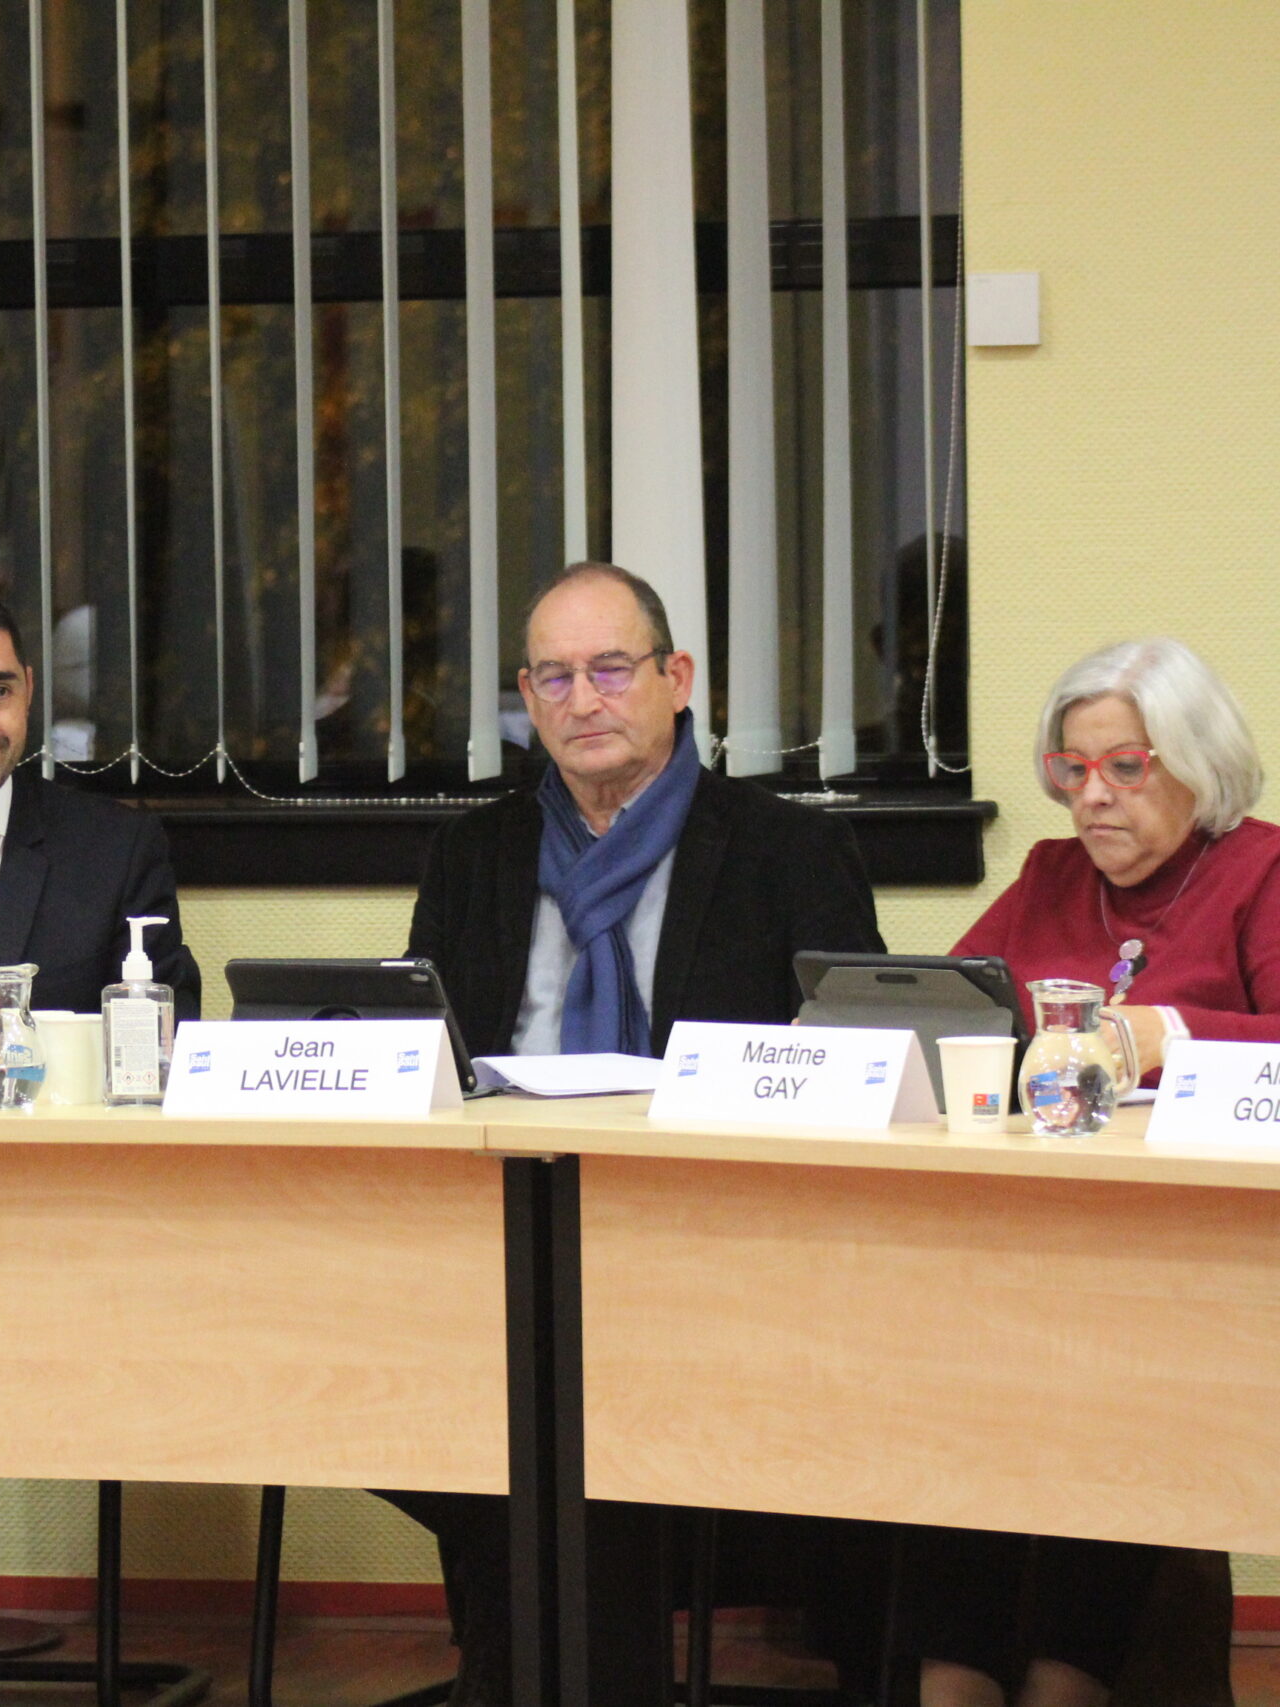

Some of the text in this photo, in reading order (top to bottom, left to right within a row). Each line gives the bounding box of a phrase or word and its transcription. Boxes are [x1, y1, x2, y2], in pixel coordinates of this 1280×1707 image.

[274, 1036, 335, 1058] Jean
[742, 1040, 826, 1066] Martine
[240, 1069, 369, 1091] LAVIELLE
[754, 1076, 808, 1099] GAY
